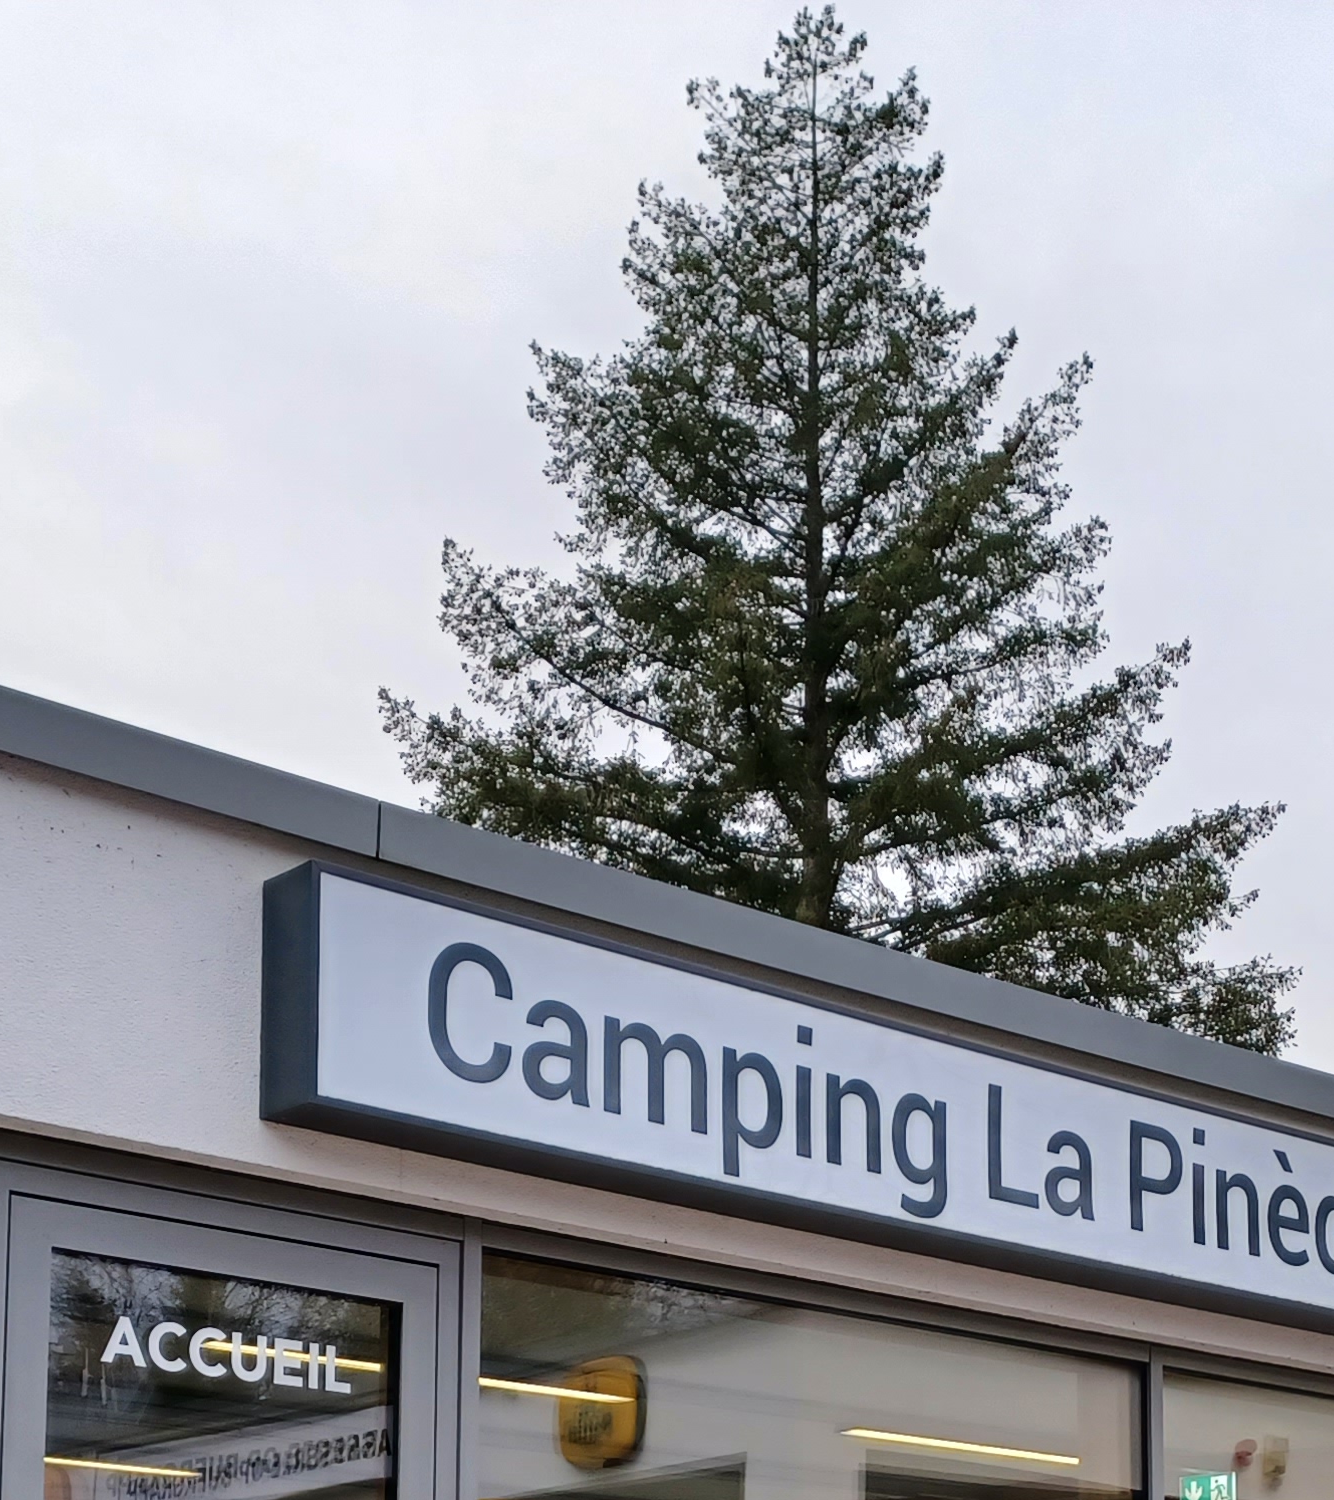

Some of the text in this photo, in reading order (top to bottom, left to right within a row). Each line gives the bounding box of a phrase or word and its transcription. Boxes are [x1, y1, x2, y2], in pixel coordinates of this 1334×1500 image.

[427, 941, 948, 1219] Camping
[987, 1082, 1096, 1222] La
[100, 1315, 352, 1395] ACCUEIL
